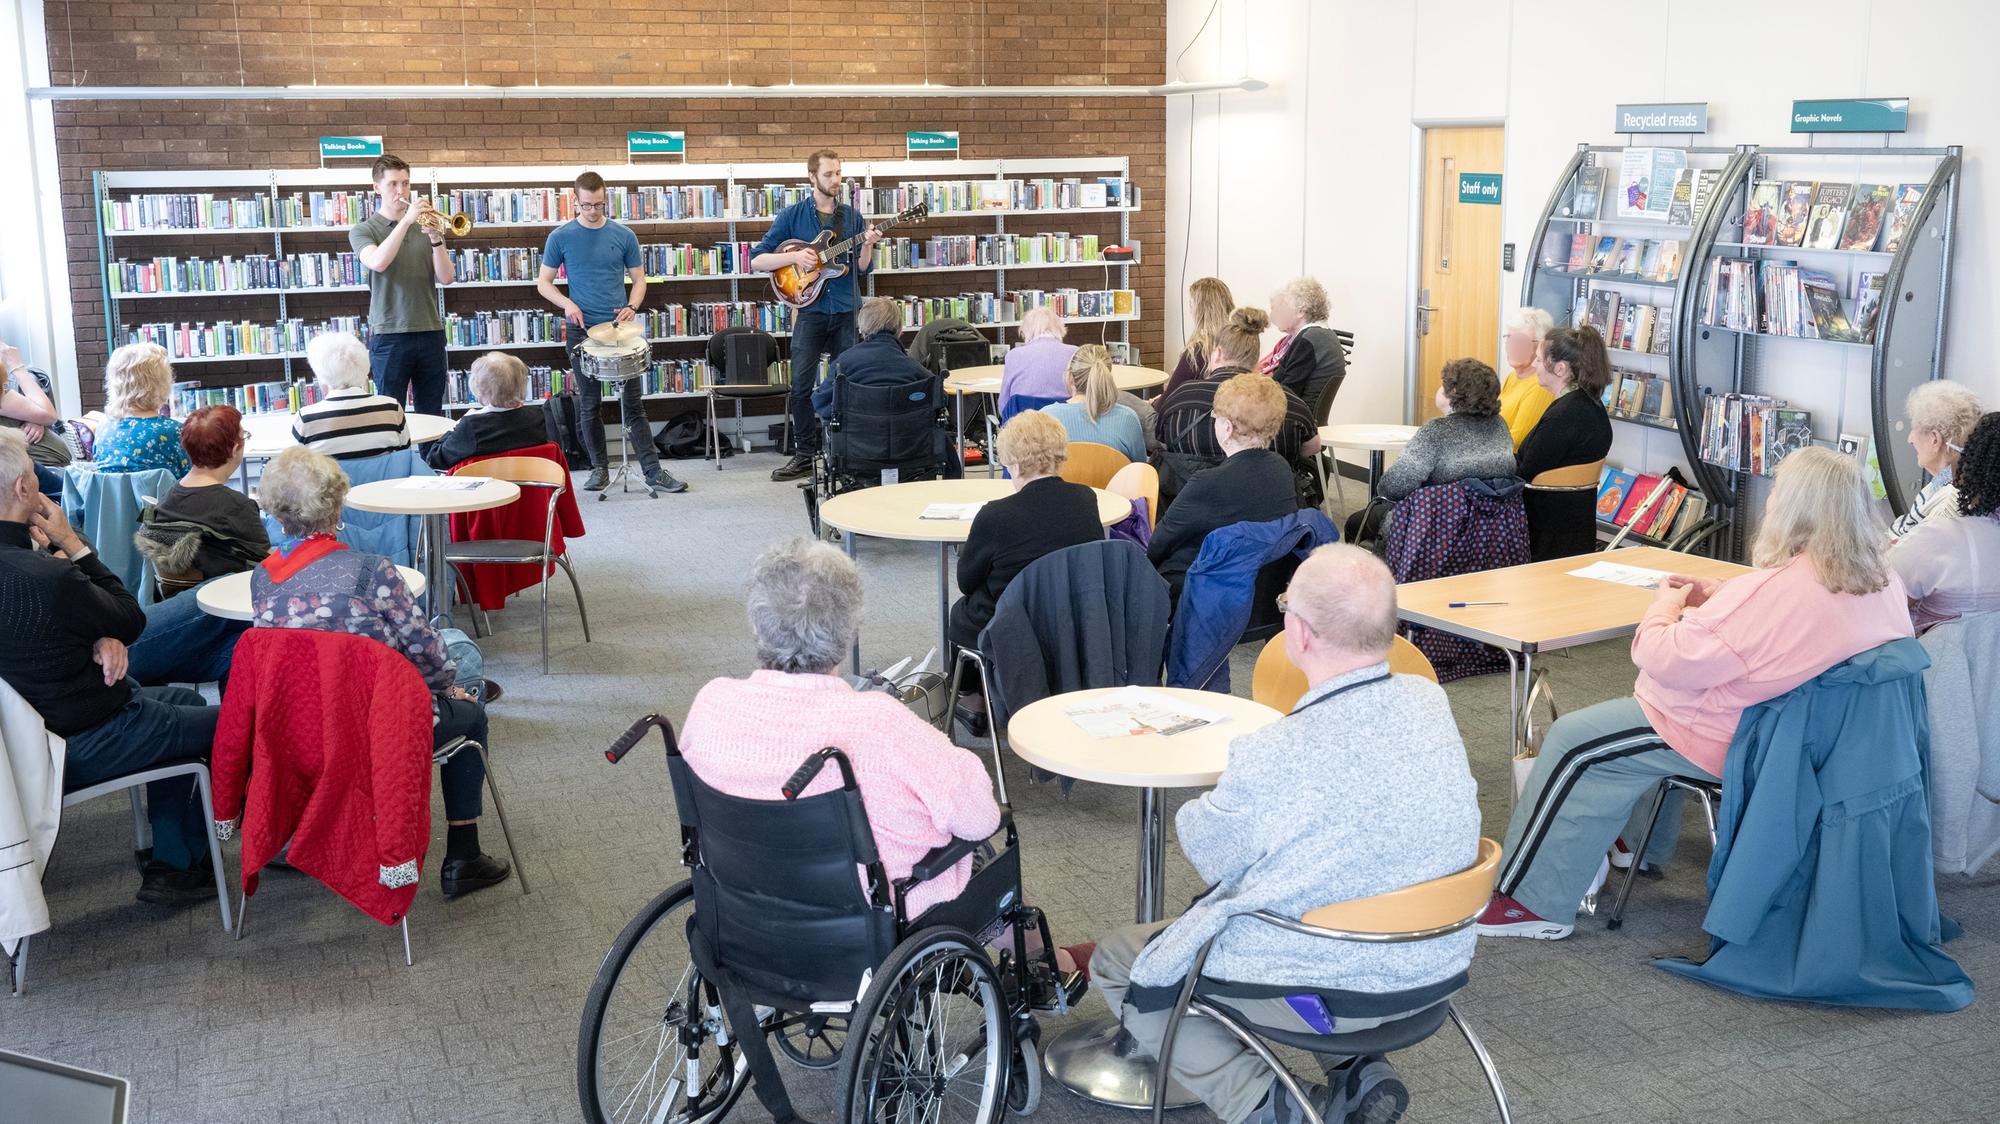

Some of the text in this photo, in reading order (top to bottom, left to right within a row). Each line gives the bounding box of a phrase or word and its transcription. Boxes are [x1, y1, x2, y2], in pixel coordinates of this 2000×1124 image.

[1623, 112, 1697, 130] Recycled reads
[1794, 113, 1842, 124] Graphic Novels
[1461, 180, 1498, 199] Staff only
